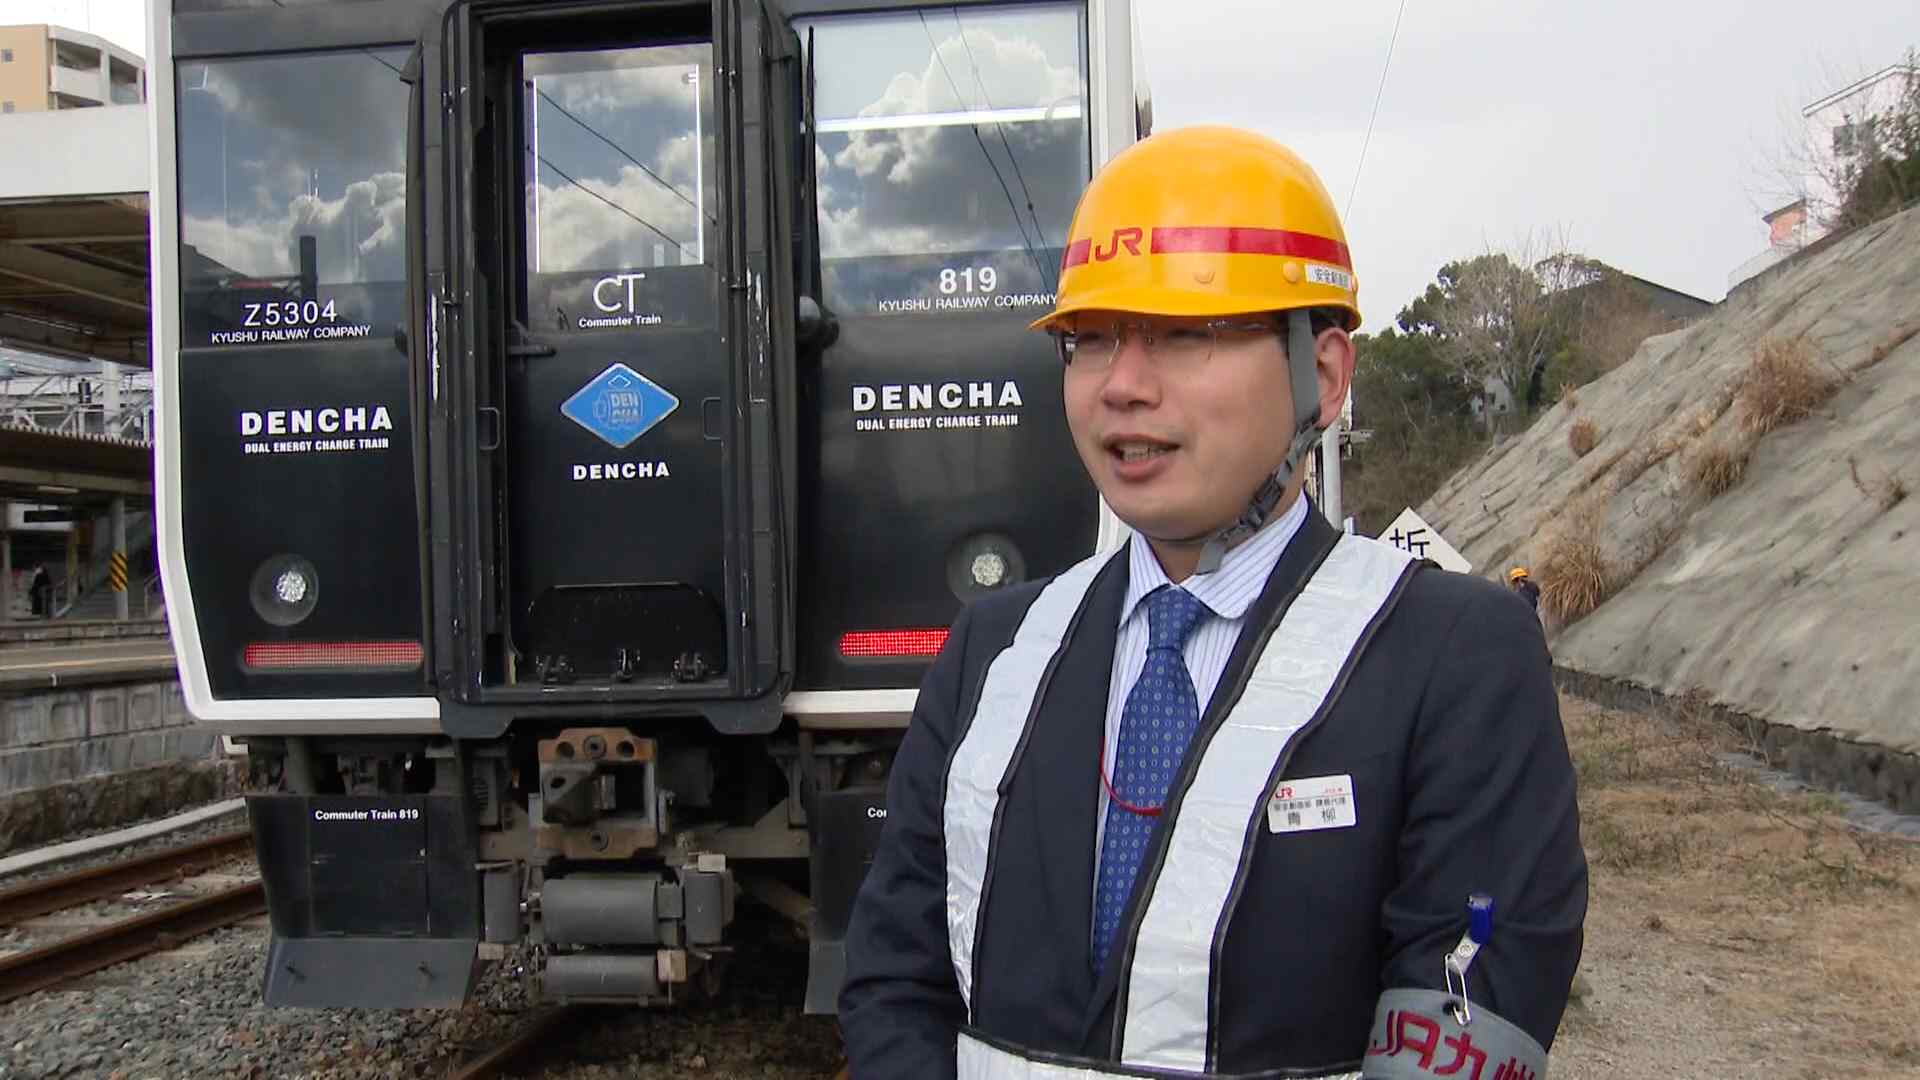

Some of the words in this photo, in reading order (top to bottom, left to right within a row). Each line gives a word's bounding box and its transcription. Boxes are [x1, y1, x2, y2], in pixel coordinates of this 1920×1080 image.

[1095, 227, 1143, 262] JR
[939, 266, 998, 294] 819
[593, 273, 645, 313] CT
[879, 299, 931, 312] KYUSHU
[935, 296, 989, 309] RAILWAY
[994, 293, 1057, 307] COMPANY
[244, 299, 337, 327] Z5304
[578, 316, 633, 328] Commuter
[635, 314, 662, 325] Train
[211, 331, 258, 344] KYUSHU
[262, 328, 310, 341] RAILWAY
[313, 325, 371, 339] COMPANY
[852, 381, 1023, 412] DENCHA
[241, 406, 393, 436] DENCHA
[856, 419, 885, 431] DUAL
[889, 417, 932, 430] ENERGY
[935, 415, 981, 428] CHARGE
[985, 414, 1018, 427] TRAIN
[244, 442, 271, 454] DUAL
[273, 440, 312, 453] ENERGY
[315, 438, 356, 451] CHARGE
[359, 437, 389, 449] TRAIN
[573, 461, 670, 481] DENCHA
[1275, 787, 1293, 799] JR
[315, 810, 369, 820] Commuter
[370, 809, 397, 819] Train
[399, 808, 419, 819] 819
